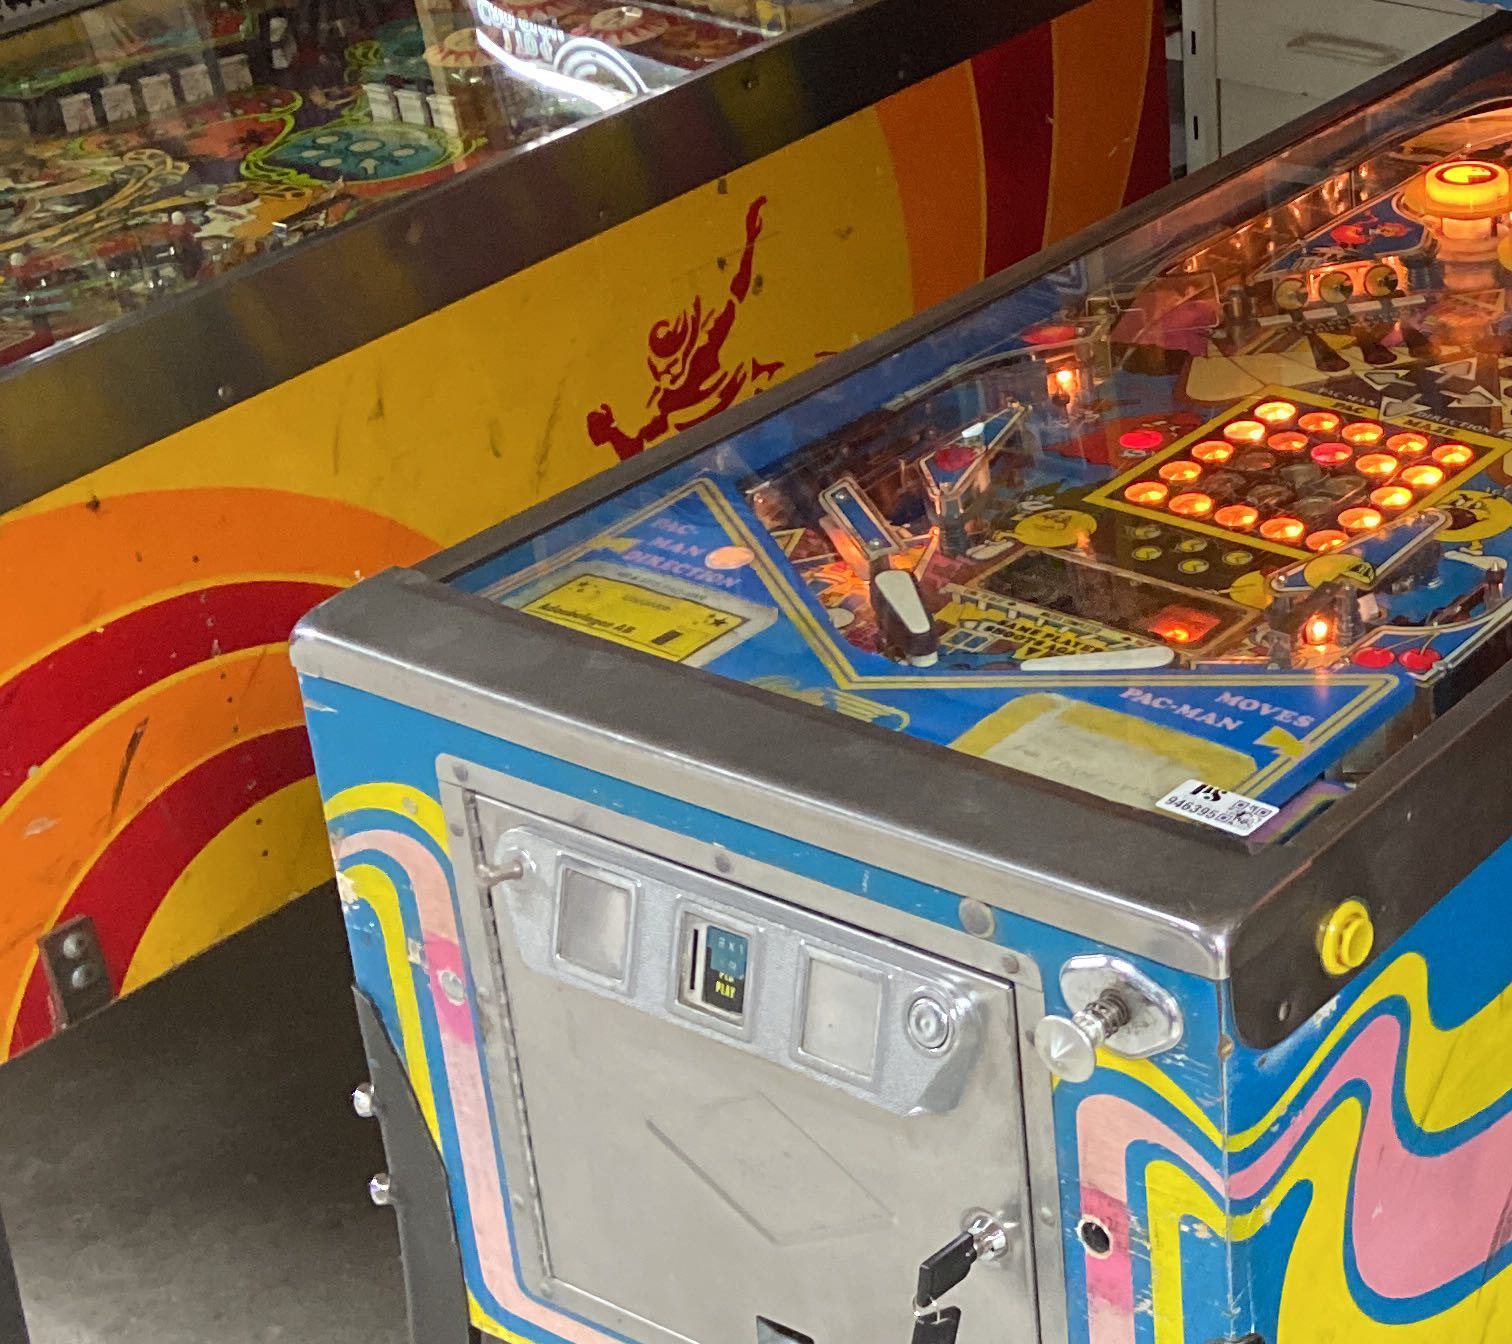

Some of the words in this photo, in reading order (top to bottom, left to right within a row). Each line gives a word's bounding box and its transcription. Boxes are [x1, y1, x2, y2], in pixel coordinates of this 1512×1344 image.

[622, 549, 743, 588] DIRECTION
[1119, 686, 1244, 732] PAC-MAN
[1214, 690, 1316, 729] MOVES
[1165, 795, 1216, 819] 946395
[715, 980, 737, 999] PLAY
